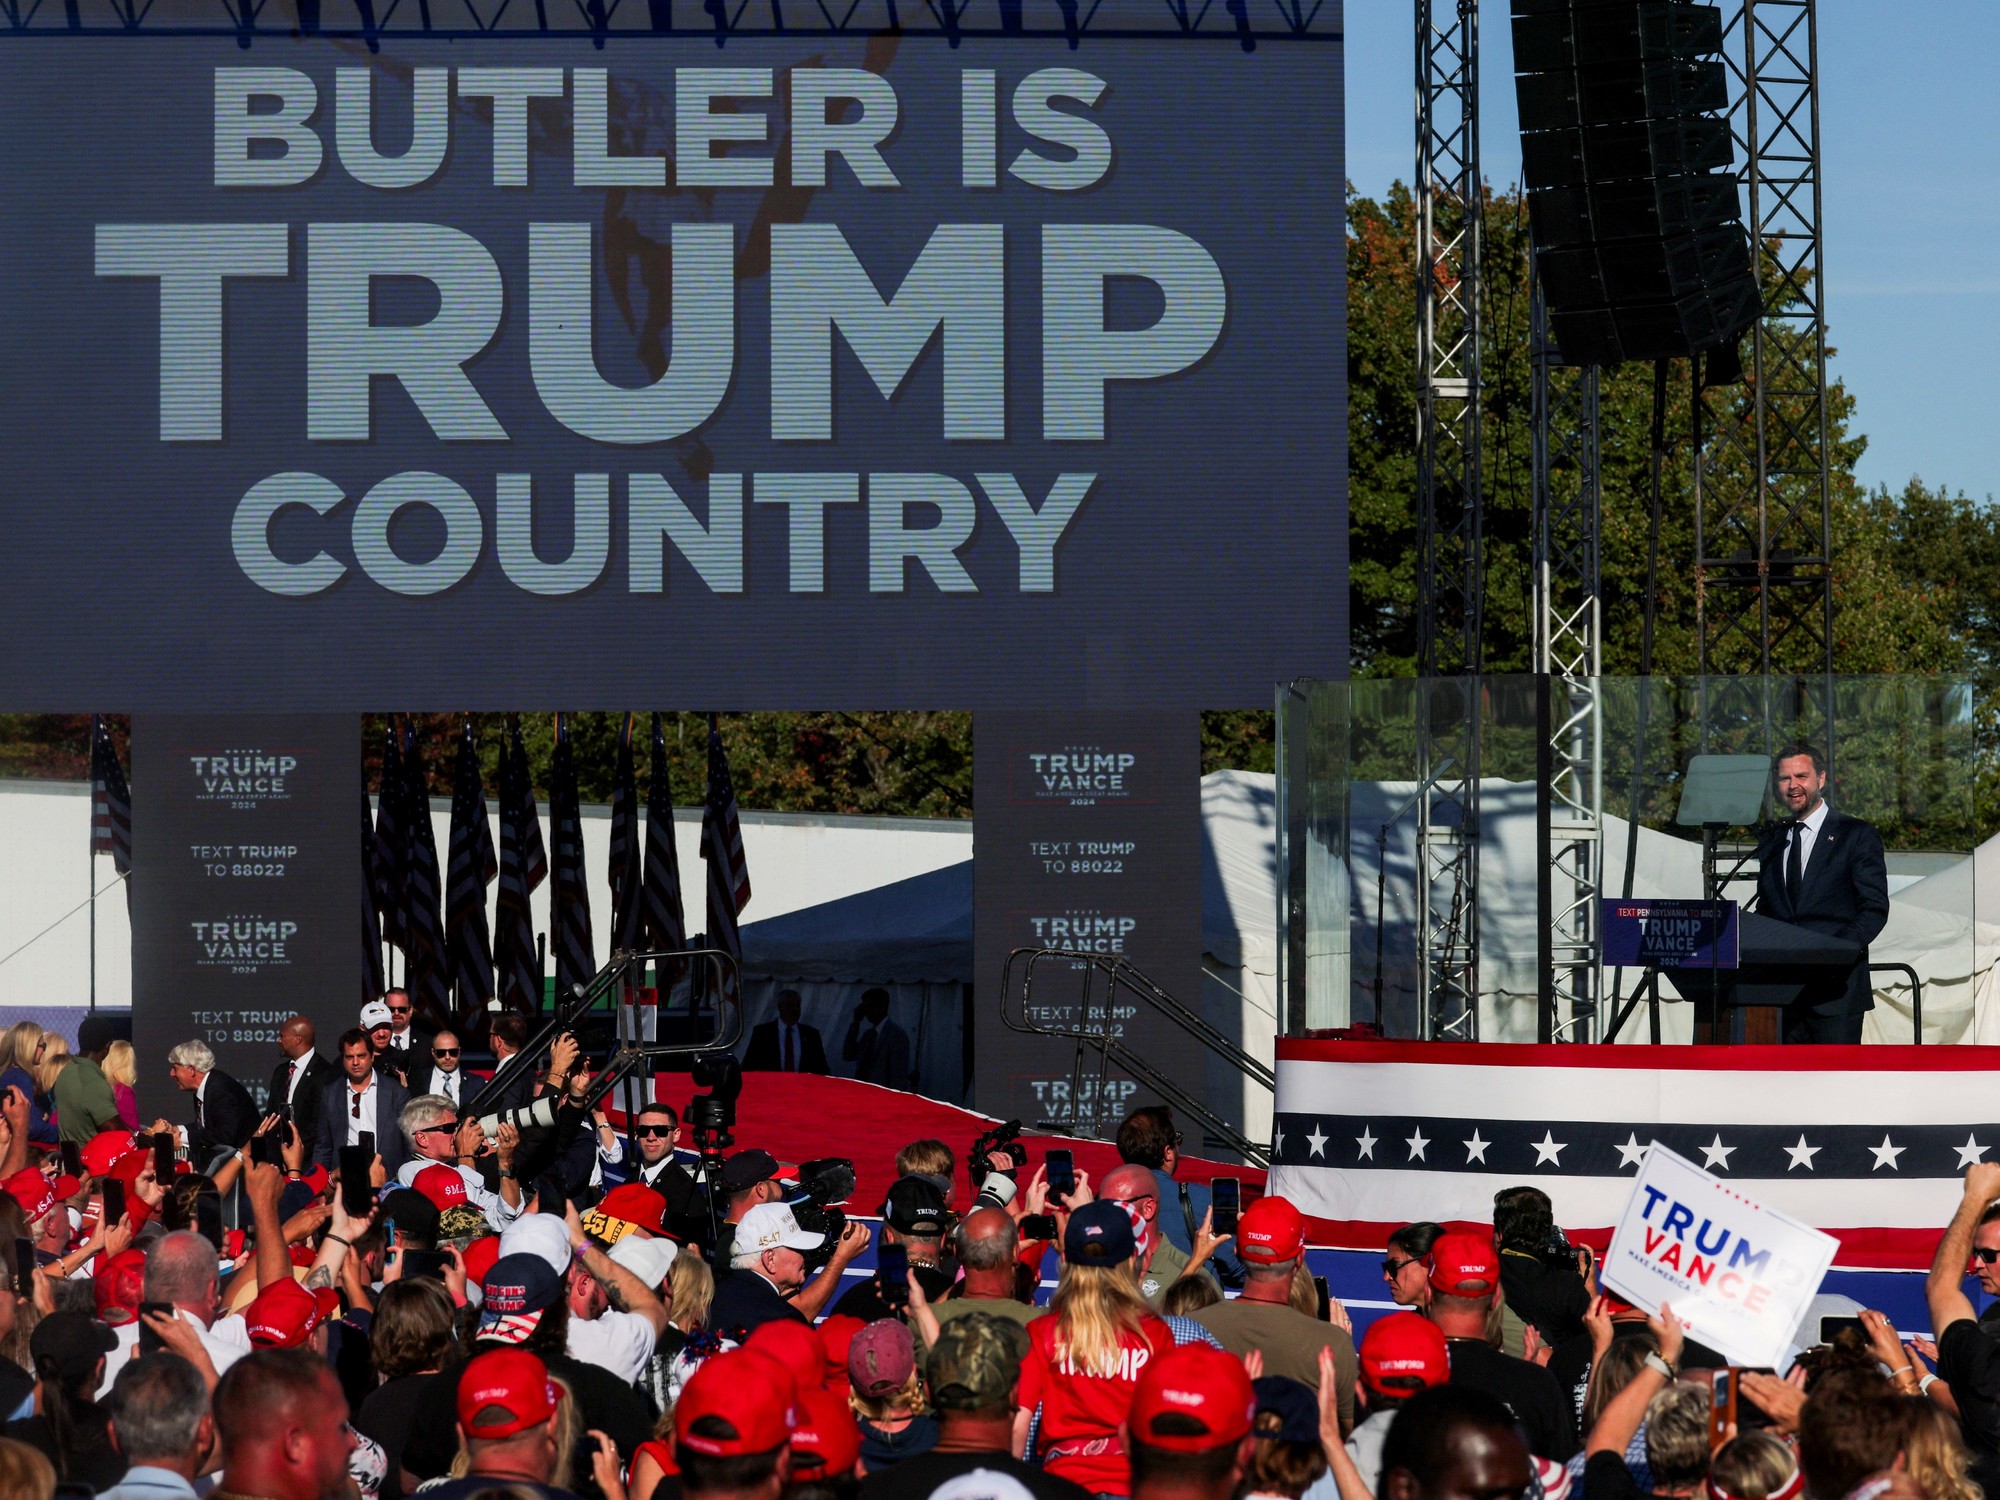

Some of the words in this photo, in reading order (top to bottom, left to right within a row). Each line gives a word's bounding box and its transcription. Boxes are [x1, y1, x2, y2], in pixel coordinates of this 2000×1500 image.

[213, 67, 901, 189] BUTLER
[961, 67, 1113, 191] IS
[94, 222, 1229, 444] TRUMP
[230, 471, 1099, 596] COUNTRY
[190, 756, 297, 776] TRUMP
[1029, 754, 1135, 773] TRUMP
[203, 778, 284, 793] VANCE
[1043, 774, 1123, 790] VANCE
[231, 801, 256, 809] 2024
[1070, 798, 1095, 806] 2024
[190, 846, 233, 859] TEXT
[238, 846, 298, 858] TRUMP
[1029, 842, 1072, 855] TEXT
[1077, 842, 1135, 855] TRUMP
[205, 864, 227, 877] TO
[232, 864, 285, 877] 88022
[1043, 860, 1066, 873] TO
[1071, 860, 1123, 873] 88022
[1618, 908, 1636, 917] TEXT
[1637, 908, 1689, 918] PENNSYLVANIA
[1690, 909, 1699, 918] TO
[1701, 909, 1722, 918] 8802
[191, 921, 297, 941] TRUMP
[1030, 917, 1136, 937] TRUMP
[1638, 918, 1701, 937] TRUMP
[204, 943, 286, 958] VANCE
[1043, 938, 1124, 953] VANCE
[1646, 936, 1695, 951] VANCE
[1070, 962, 1096, 970] 204
[1660, 957, 1680, 966] 2024
[231, 966, 257, 974] 2024
[191, 1011, 234, 1024] TEXT
[1030, 1006, 1073, 1020] TEXT
[205, 1029, 227, 1043] TO
[37, 1191, 55, 1213] 45-47
[916, 1208, 939, 1216] TRUMP
[758, 1231, 781, 1247] 45-47
[1247, 1231, 1272, 1242] TRUMP
[1459, 1265, 1486, 1273] TRUMP
[1628, 1249, 1649, 1268] MAKE
[1651, 1265, 1691, 1292] AMERICA
[1642, 1225, 1772, 1314] VANCE
[485, 1299, 527, 1312] TRUMP
